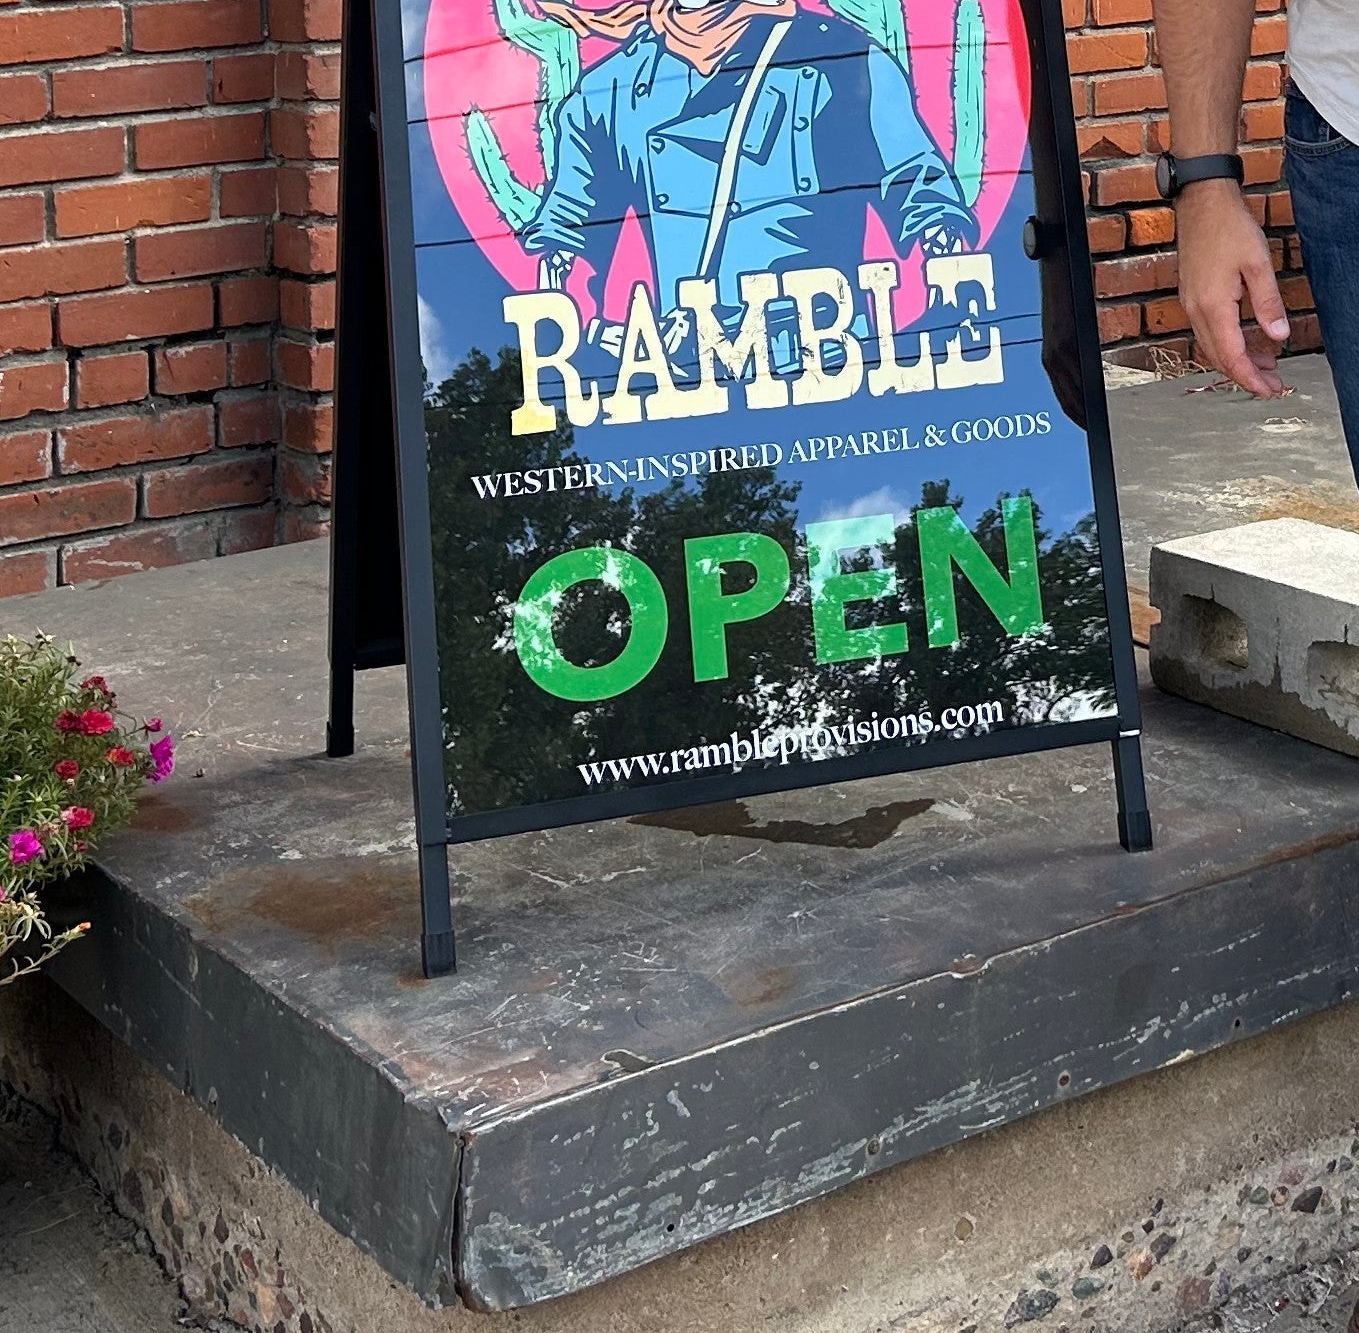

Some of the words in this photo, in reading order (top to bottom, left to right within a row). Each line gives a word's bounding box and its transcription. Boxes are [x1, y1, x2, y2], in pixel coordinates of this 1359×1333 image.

[502, 253, 1003, 436] RAMBLE
[470, 442, 783, 500] WESTERN-INSPIRED
[788, 427, 920, 464] APPAREL
[924, 424, 948, 447] &
[951, 411, 1052, 444] GOODS
[513, 496, 1044, 702] OPEN
[577, 700, 1003, 786] www.rambleprovisions.com
